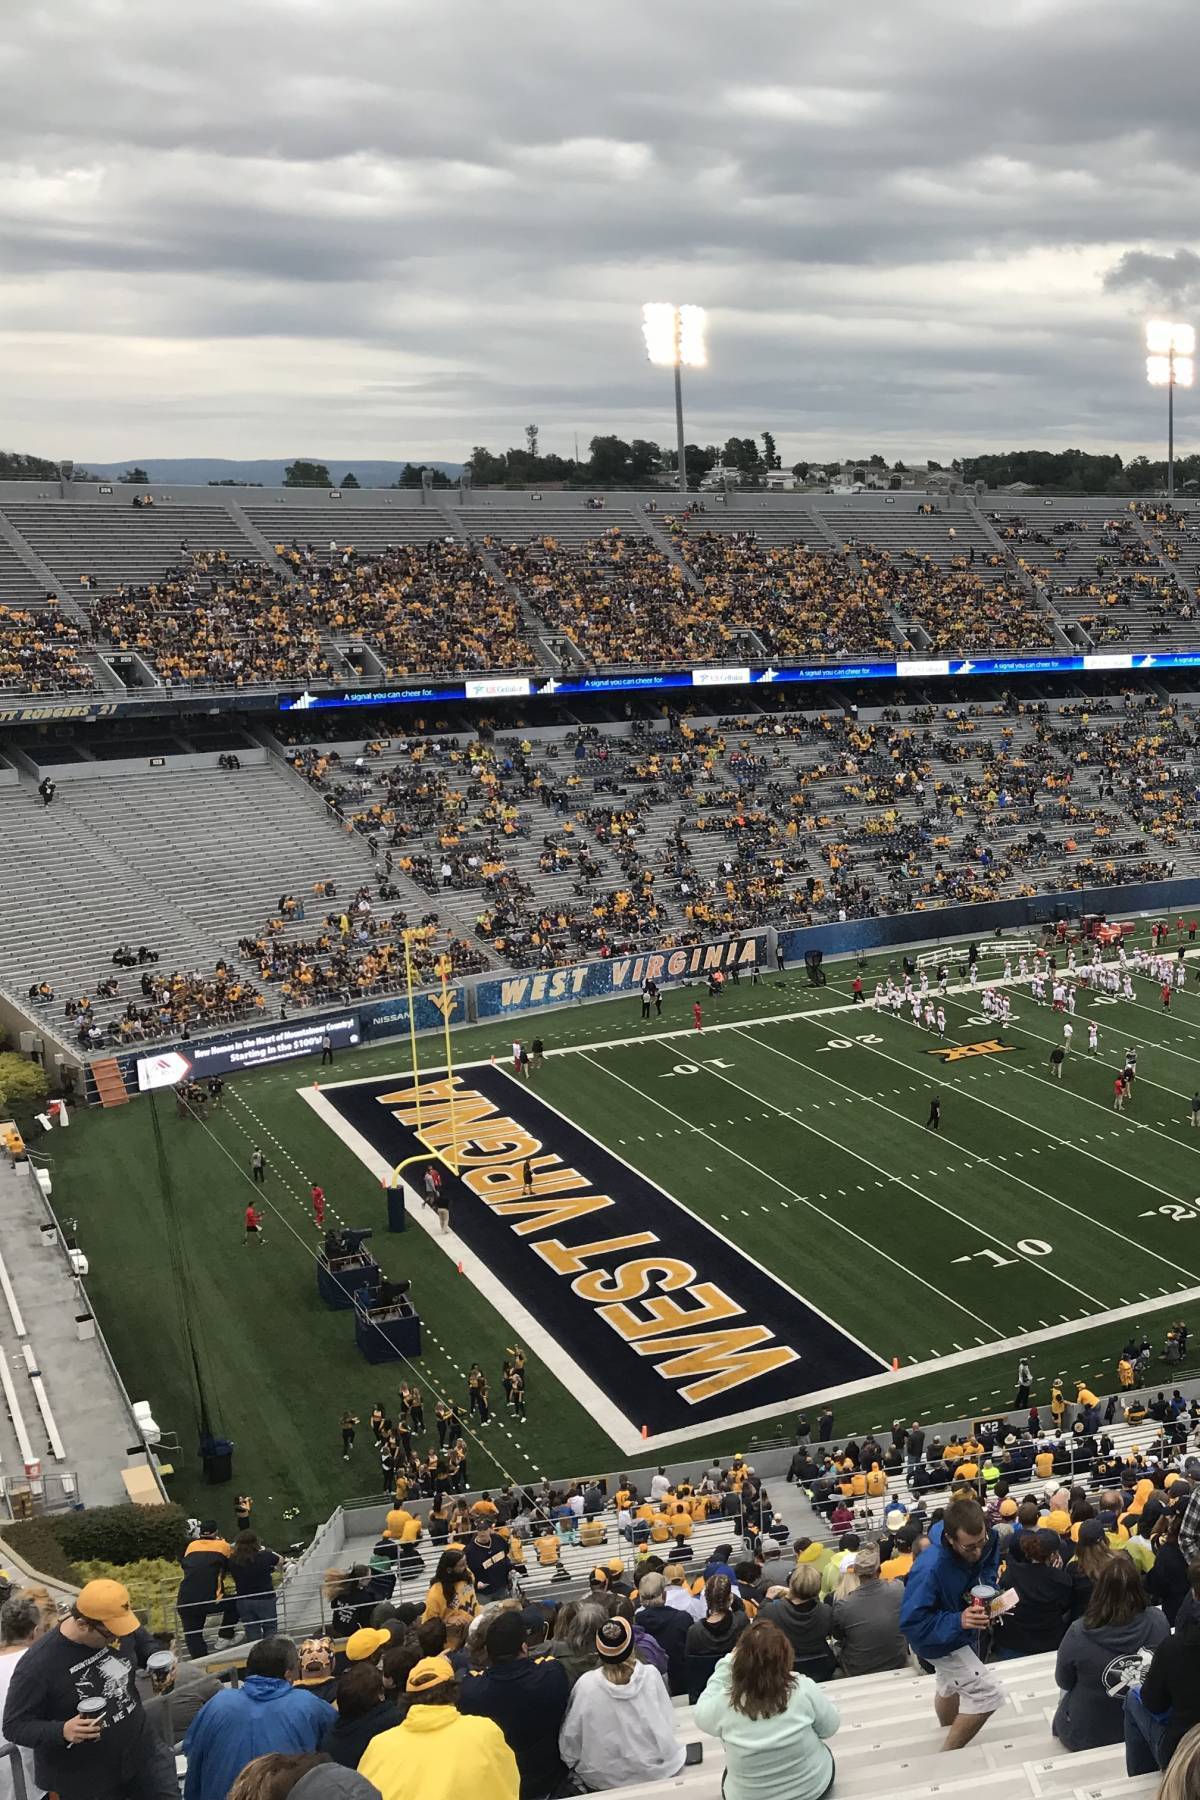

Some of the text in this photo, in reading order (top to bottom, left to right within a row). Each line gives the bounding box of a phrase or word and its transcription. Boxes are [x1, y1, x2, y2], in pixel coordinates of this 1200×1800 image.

[805, 669, 821, 677] signal
[591, 679, 609, 688] signal
[344, 693, 350, 701] A
[350, 691, 372, 701] signal
[373, 692, 386, 700] you
[401, 689, 420, 698] cheer
[20, 705, 92, 720] RODGERS
[97, 704, 119, 715] 21
[500, 939, 757, 1006] WEST VIRGINIA
[373, 1012, 410, 1025] NISSAN
[235, 1043, 242, 1051] in
[243, 1039, 255, 1049] the
[256, 1036, 275, 1047] Heart
[276, 1034, 284, 1042] of
[284, 1026, 325, 1041] Mountaineer
[326, 1019, 354, 1032] Country!
[827, 1034, 884, 1050] 20
[231, 1047, 267, 1062] Starting
[267, 1045, 276, 1054] in
[277, 1042, 292, 1052] the
[673, 1058, 735, 1076] 10
[375, 1076, 800, 1405] WEST VIRGINIA
[970, 1238, 1053, 1267] 10
